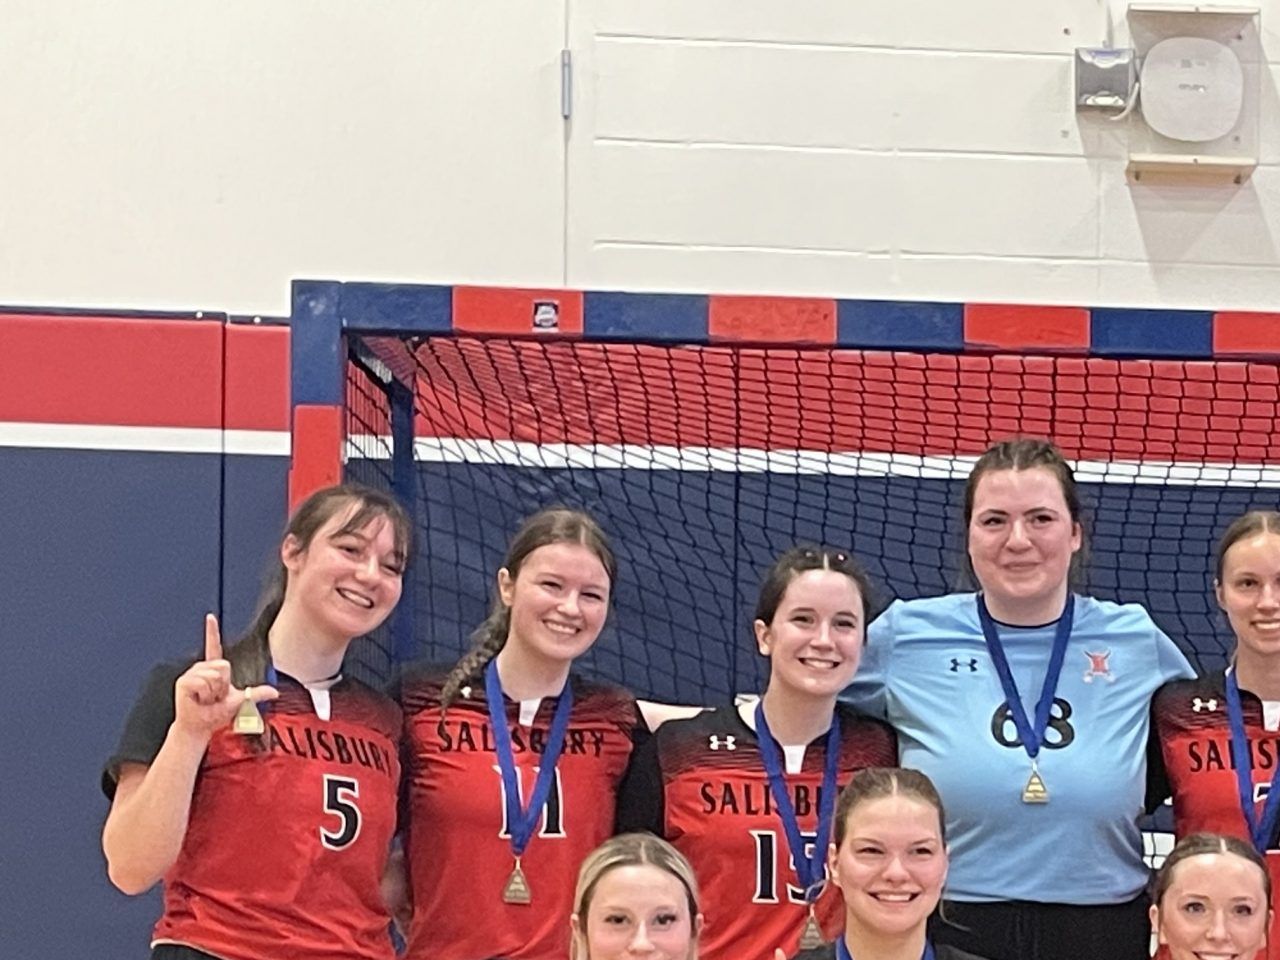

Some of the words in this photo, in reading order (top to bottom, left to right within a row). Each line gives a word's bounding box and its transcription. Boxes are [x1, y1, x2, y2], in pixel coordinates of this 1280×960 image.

[437, 720, 604, 757] SALSBRY
[991, 696, 1075, 750] 68
[267, 725, 392, 778] ALISBURY
[320, 773, 362, 851] 5
[749, 829, 829, 905] 15
